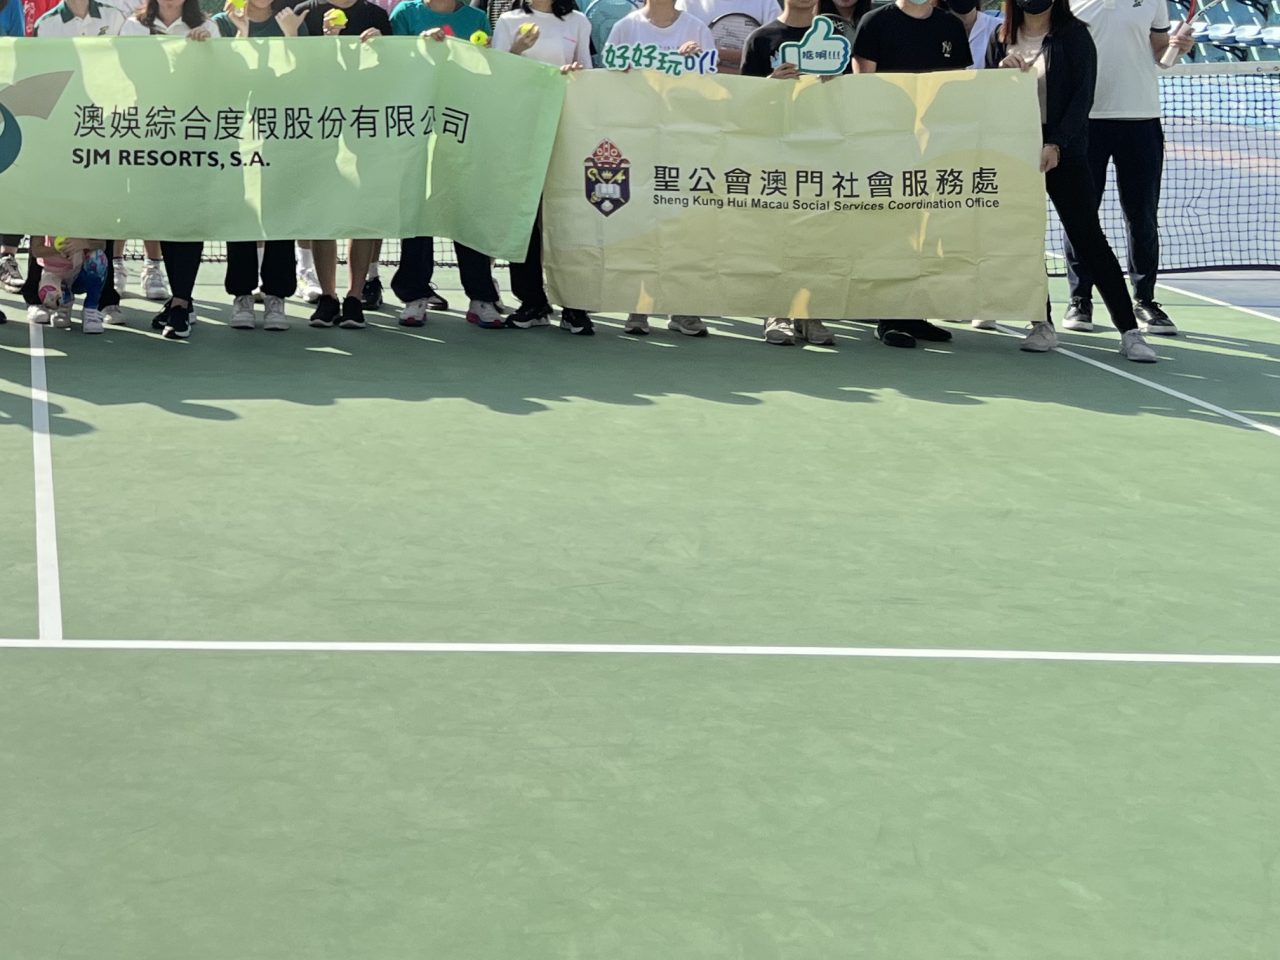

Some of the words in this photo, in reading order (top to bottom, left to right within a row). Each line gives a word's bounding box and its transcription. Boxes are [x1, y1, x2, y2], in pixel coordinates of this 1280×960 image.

[74, 103, 469, 144] 澳娛綜合度假股份有限公司
[72, 148, 110, 168] SJM
[119, 149, 225, 170] RESORTS,
[230, 151, 270, 167] S.A.
[653, 165, 998, 198] 聖公會澳門社會服務處
[653, 195, 689, 207] Sheng
[693, 196, 724, 209] Kung
[727, 198, 748, 208] Hui
[751, 199, 789, 209] Macau
[793, 200, 830, 211] Social
[834, 201, 884, 211] Services
[888, 198, 962, 210] Coordination
[965, 197, 1000, 208] Office
